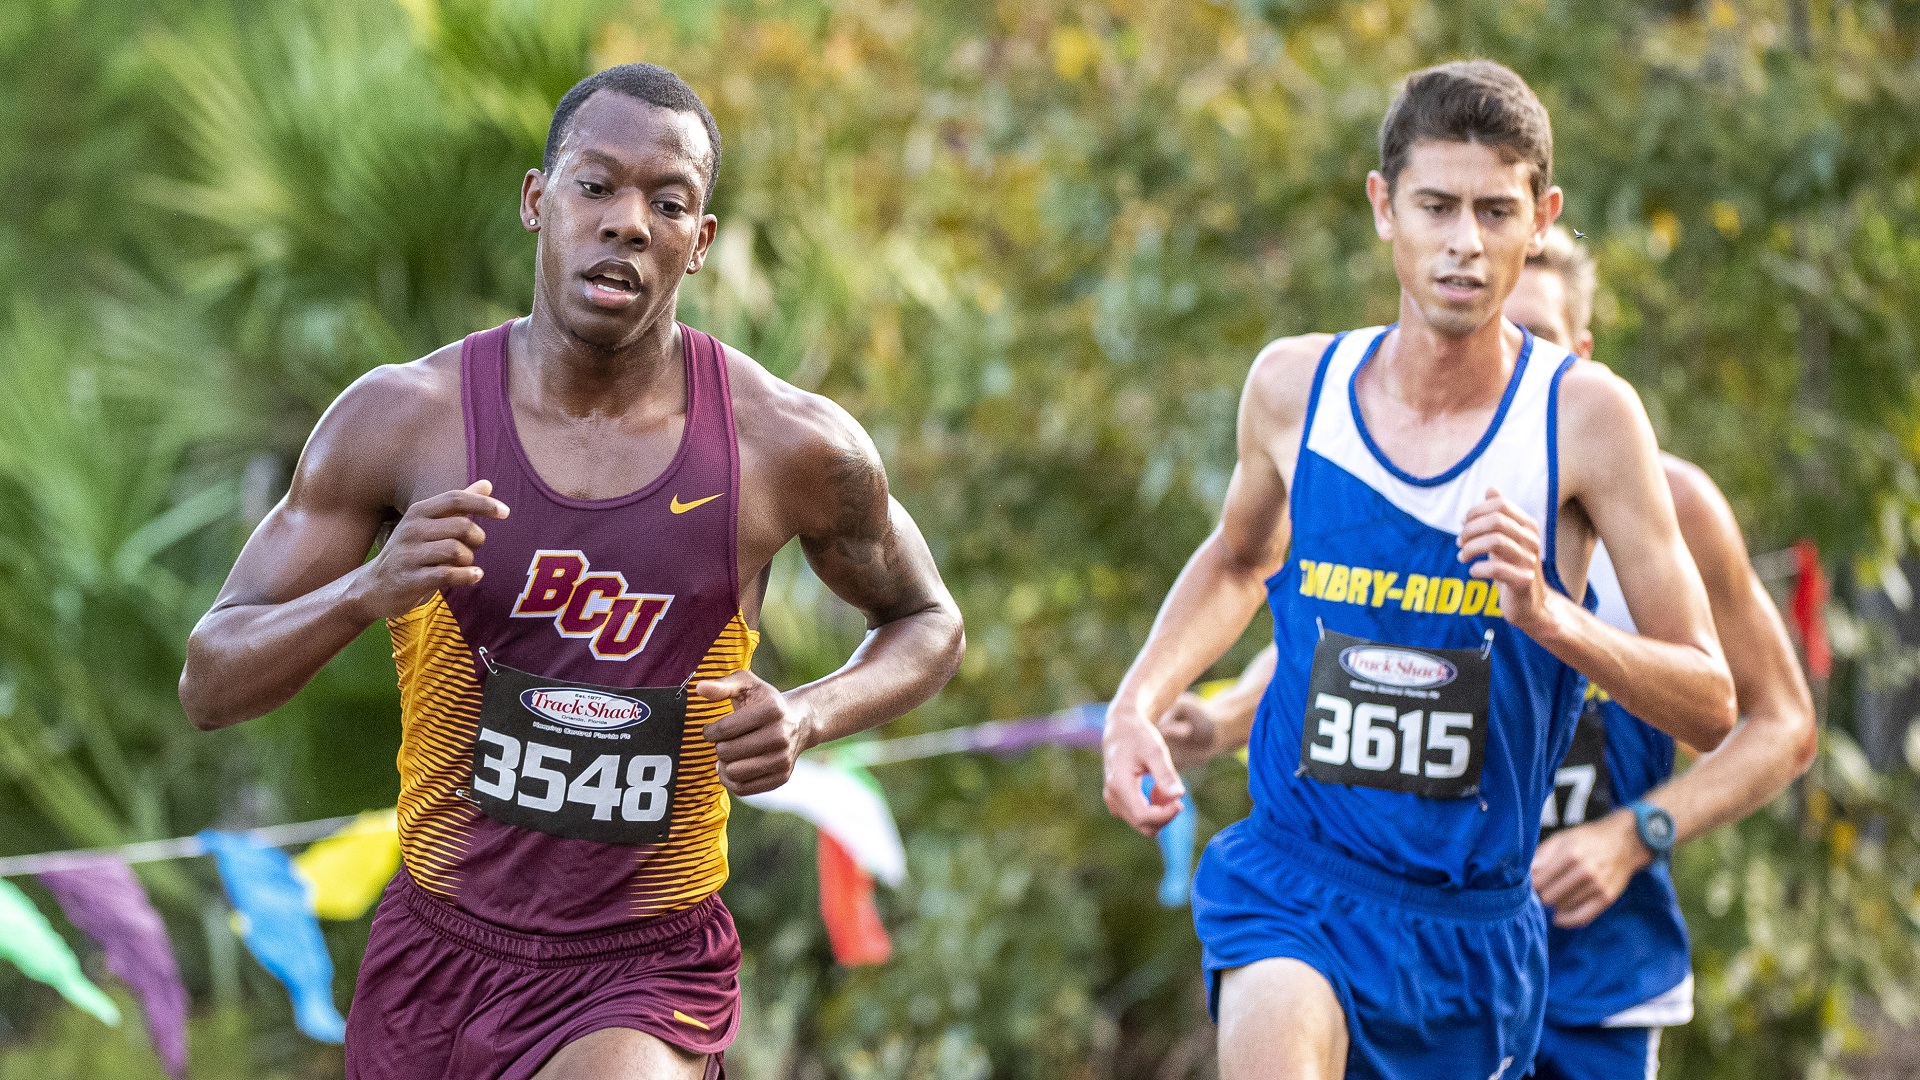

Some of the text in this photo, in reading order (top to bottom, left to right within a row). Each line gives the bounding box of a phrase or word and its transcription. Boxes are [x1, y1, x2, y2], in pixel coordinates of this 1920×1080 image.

[510, 550, 675, 661] BCU
[1299, 559, 1504, 617] MBRY-RIDDL
[531, 690, 643, 720] Track Shack
[532, 721, 563, 734] Keeping
[563, 727, 592, 738] Central
[593, 731, 619, 740] Florida
[1310, 692, 1474, 779] 3615
[474, 727, 673, 822] 3548
